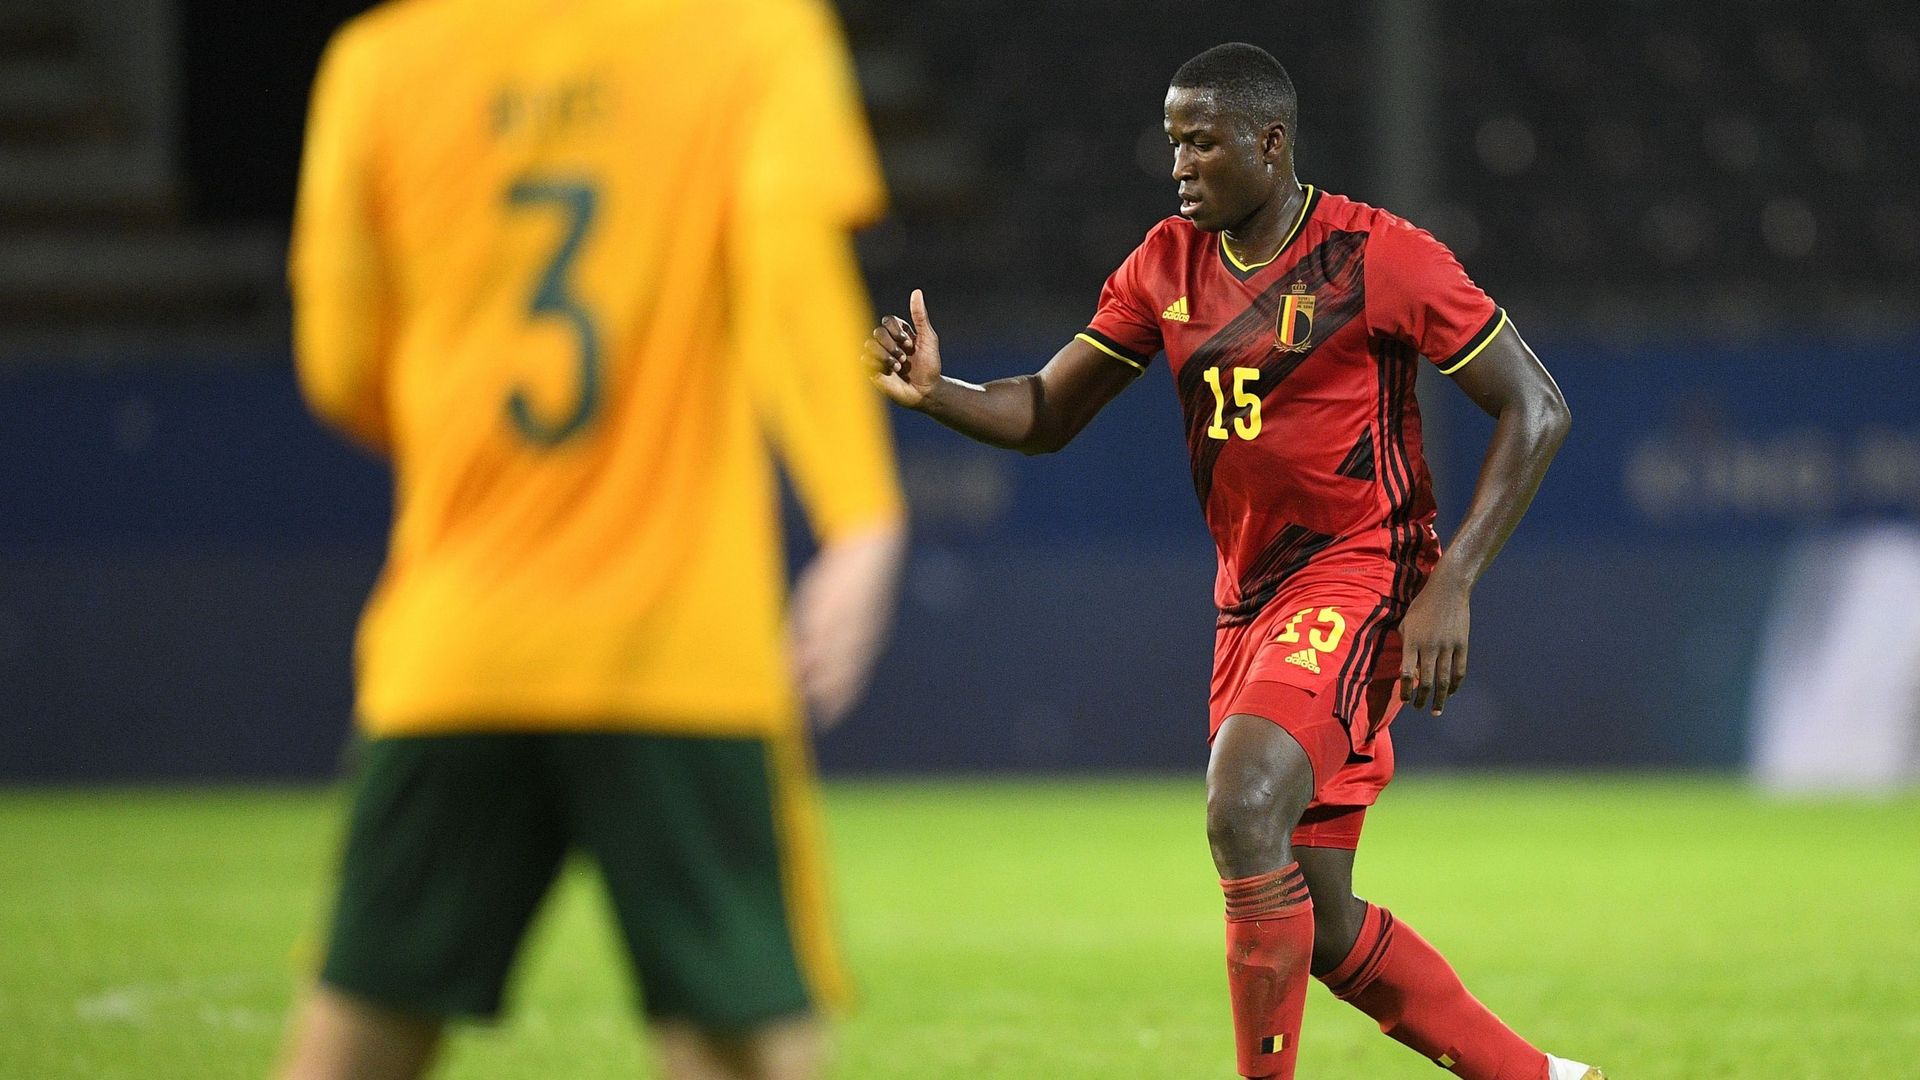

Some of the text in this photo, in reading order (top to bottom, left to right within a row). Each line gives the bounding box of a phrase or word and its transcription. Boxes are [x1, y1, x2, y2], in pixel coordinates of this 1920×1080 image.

[505, 177, 605, 449] 3
[1162, 310, 1190, 323] adidas
[1203, 366, 1263, 441] 15
[1276, 606, 1346, 653] 15
[1284, 655, 1321, 675] adidas
